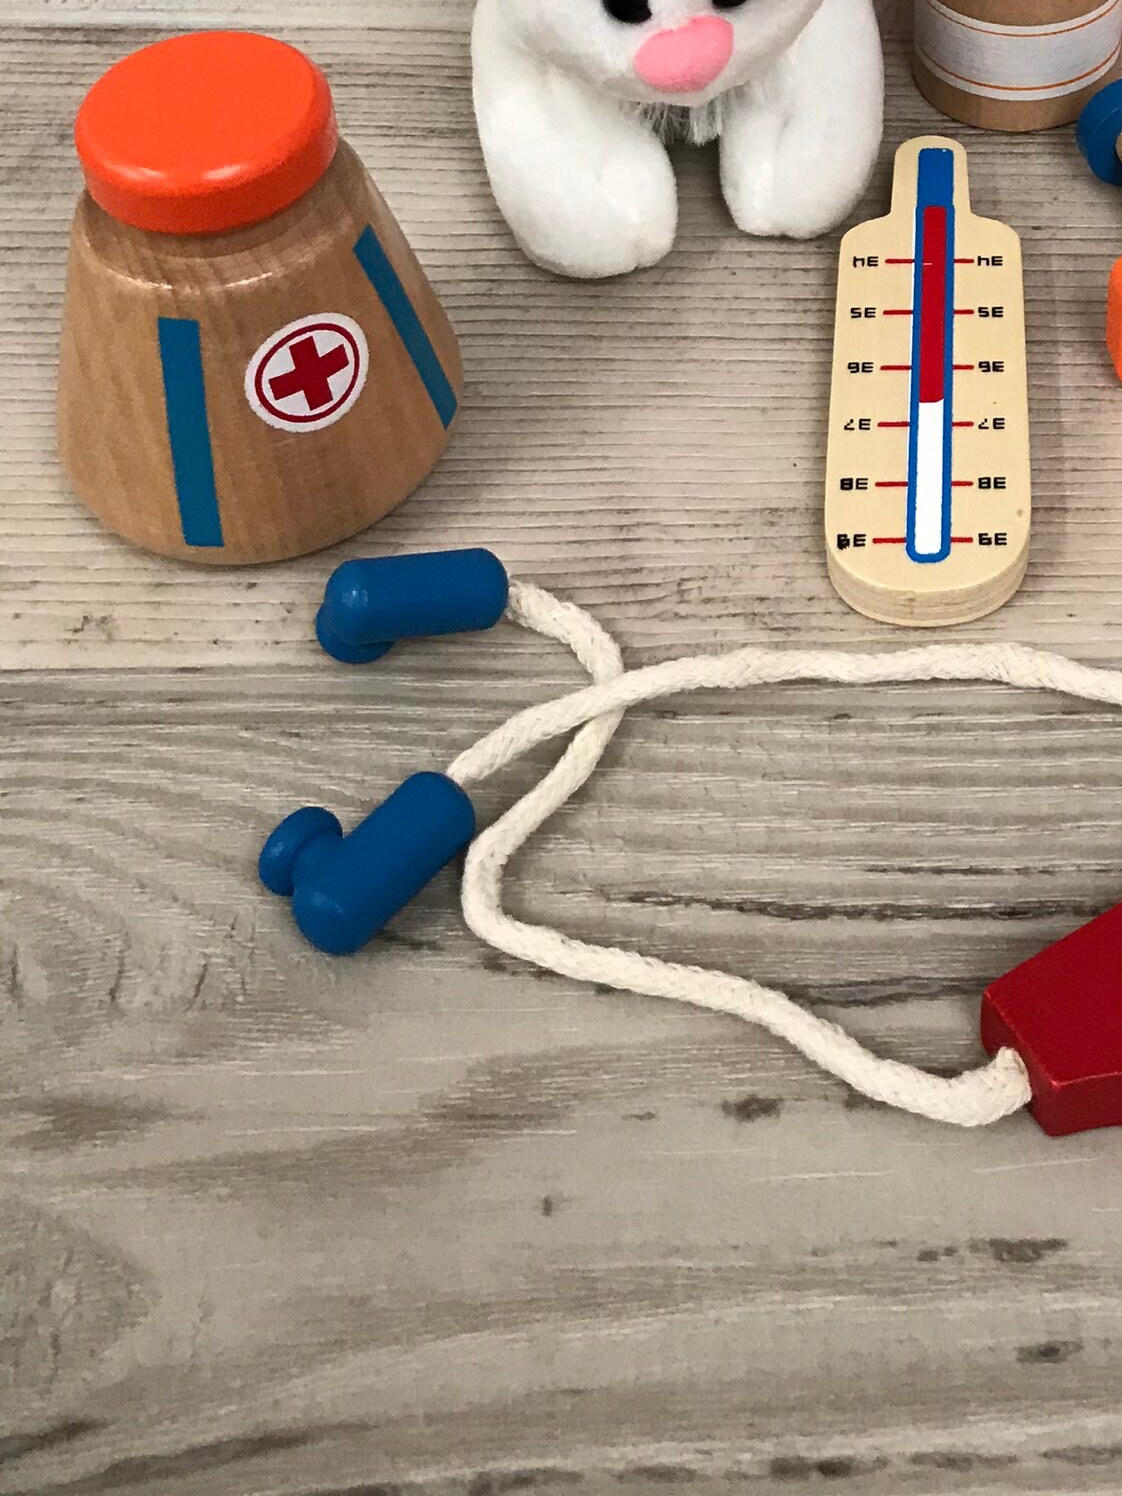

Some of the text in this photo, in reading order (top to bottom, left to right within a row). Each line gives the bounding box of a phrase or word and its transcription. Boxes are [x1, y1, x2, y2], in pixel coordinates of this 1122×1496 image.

[852, 255, 880, 268] 34
[977, 255, 1004, 267] 34
[850, 307, 877, 319] 35
[977, 306, 1004, 318] 35
[847, 361, 874, 374] 36
[978, 360, 1005, 373] 36
[843, 418, 871, 431] 37
[978, 417, 1005, 430] 37
[840, 477, 869, 491] 38
[977, 476, 1007, 490] 38
